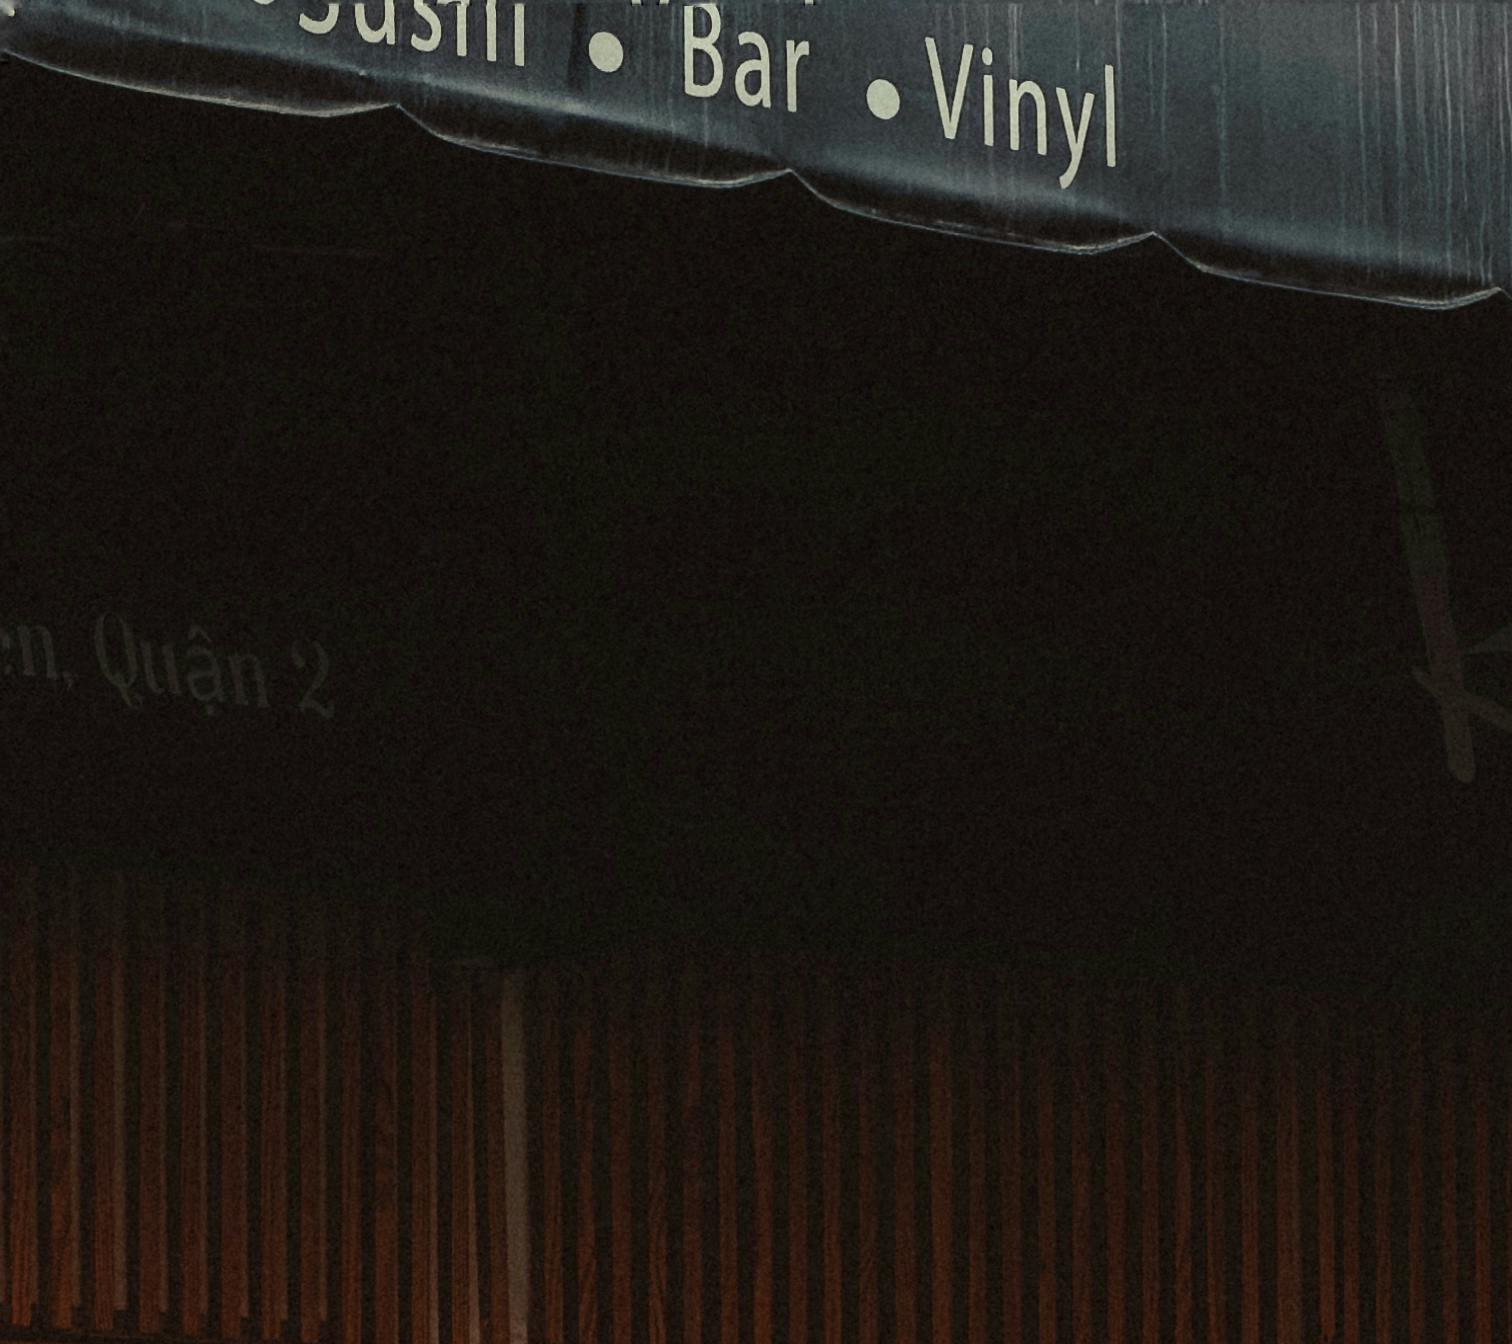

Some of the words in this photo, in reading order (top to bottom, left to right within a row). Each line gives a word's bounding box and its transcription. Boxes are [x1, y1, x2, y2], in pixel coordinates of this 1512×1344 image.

[683, 2, 810, 113] Bar
[924, 36, 1117, 189] Vinyl
[94, 611, 270, 717] Quận
[291, 640, 335, 719] 2
